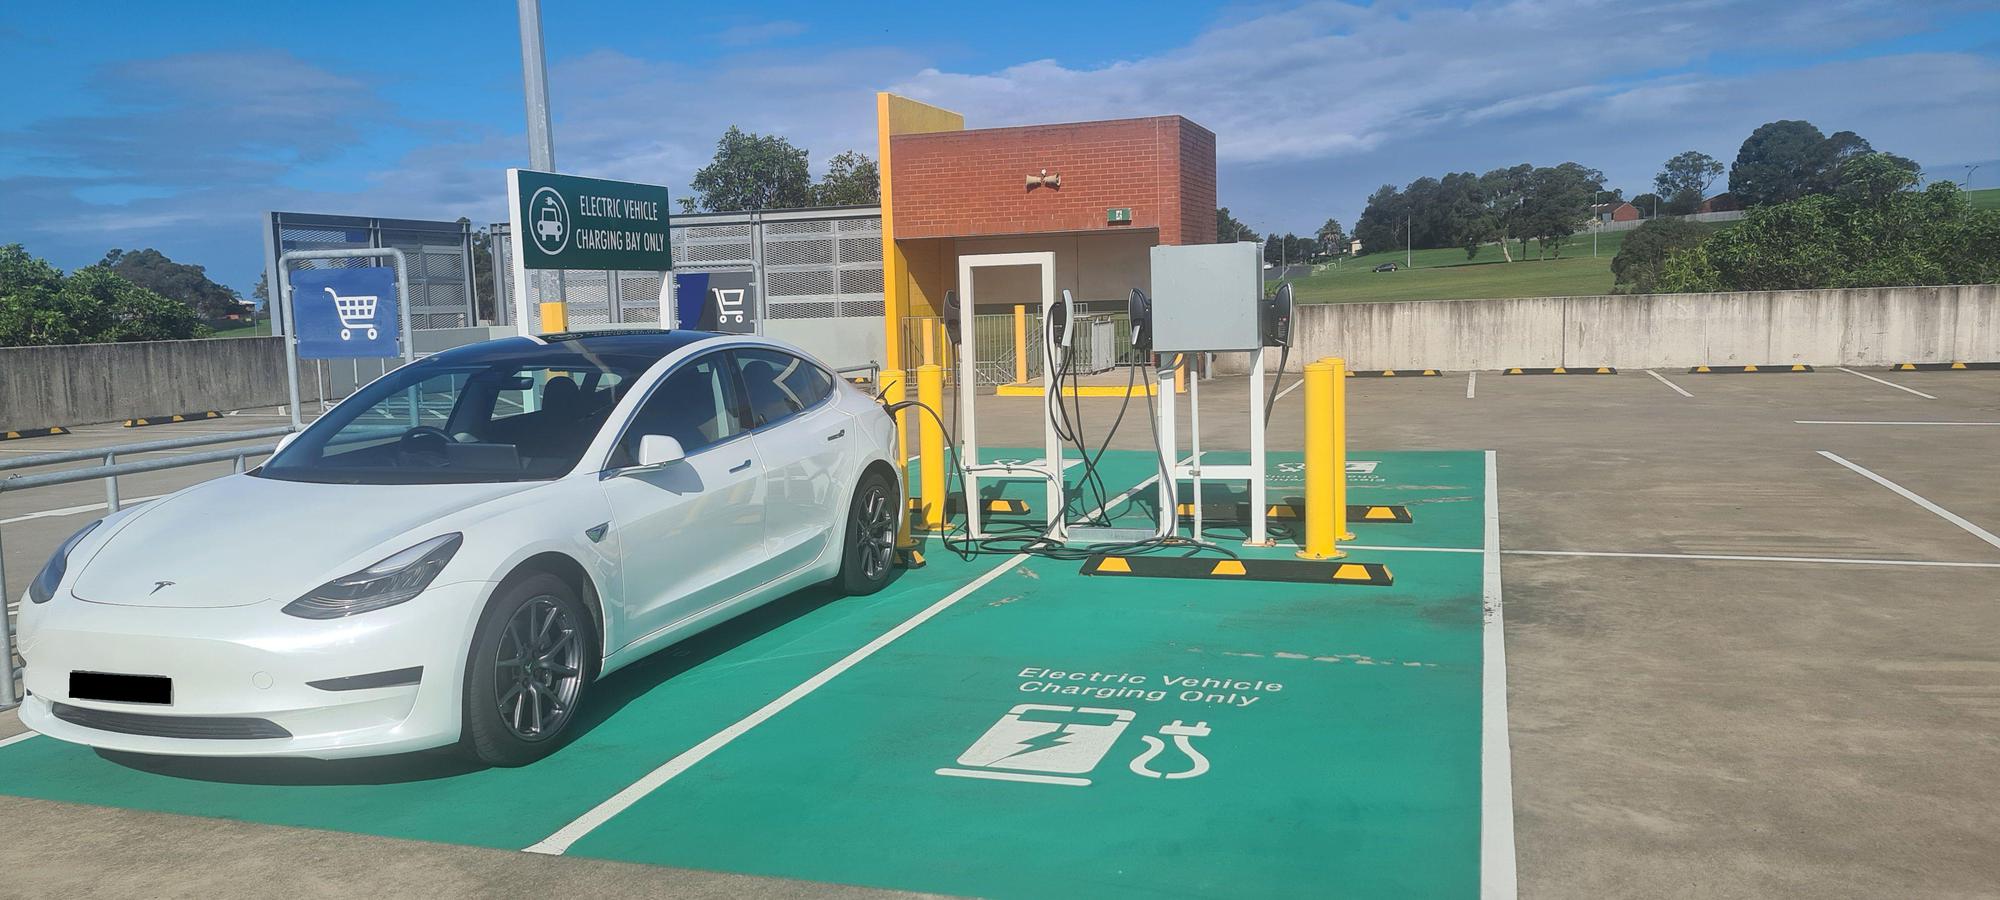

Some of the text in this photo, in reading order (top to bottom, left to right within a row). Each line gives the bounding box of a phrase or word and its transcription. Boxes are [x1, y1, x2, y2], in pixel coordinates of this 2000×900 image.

[580, 195, 658, 221] ELECTRIC VEHICLE
[576, 228, 664, 252] CHARGING BAY ONLY
[1018, 667, 1283, 692] Electric Vehicle
[1019, 681, 1260, 707] Charging Only
